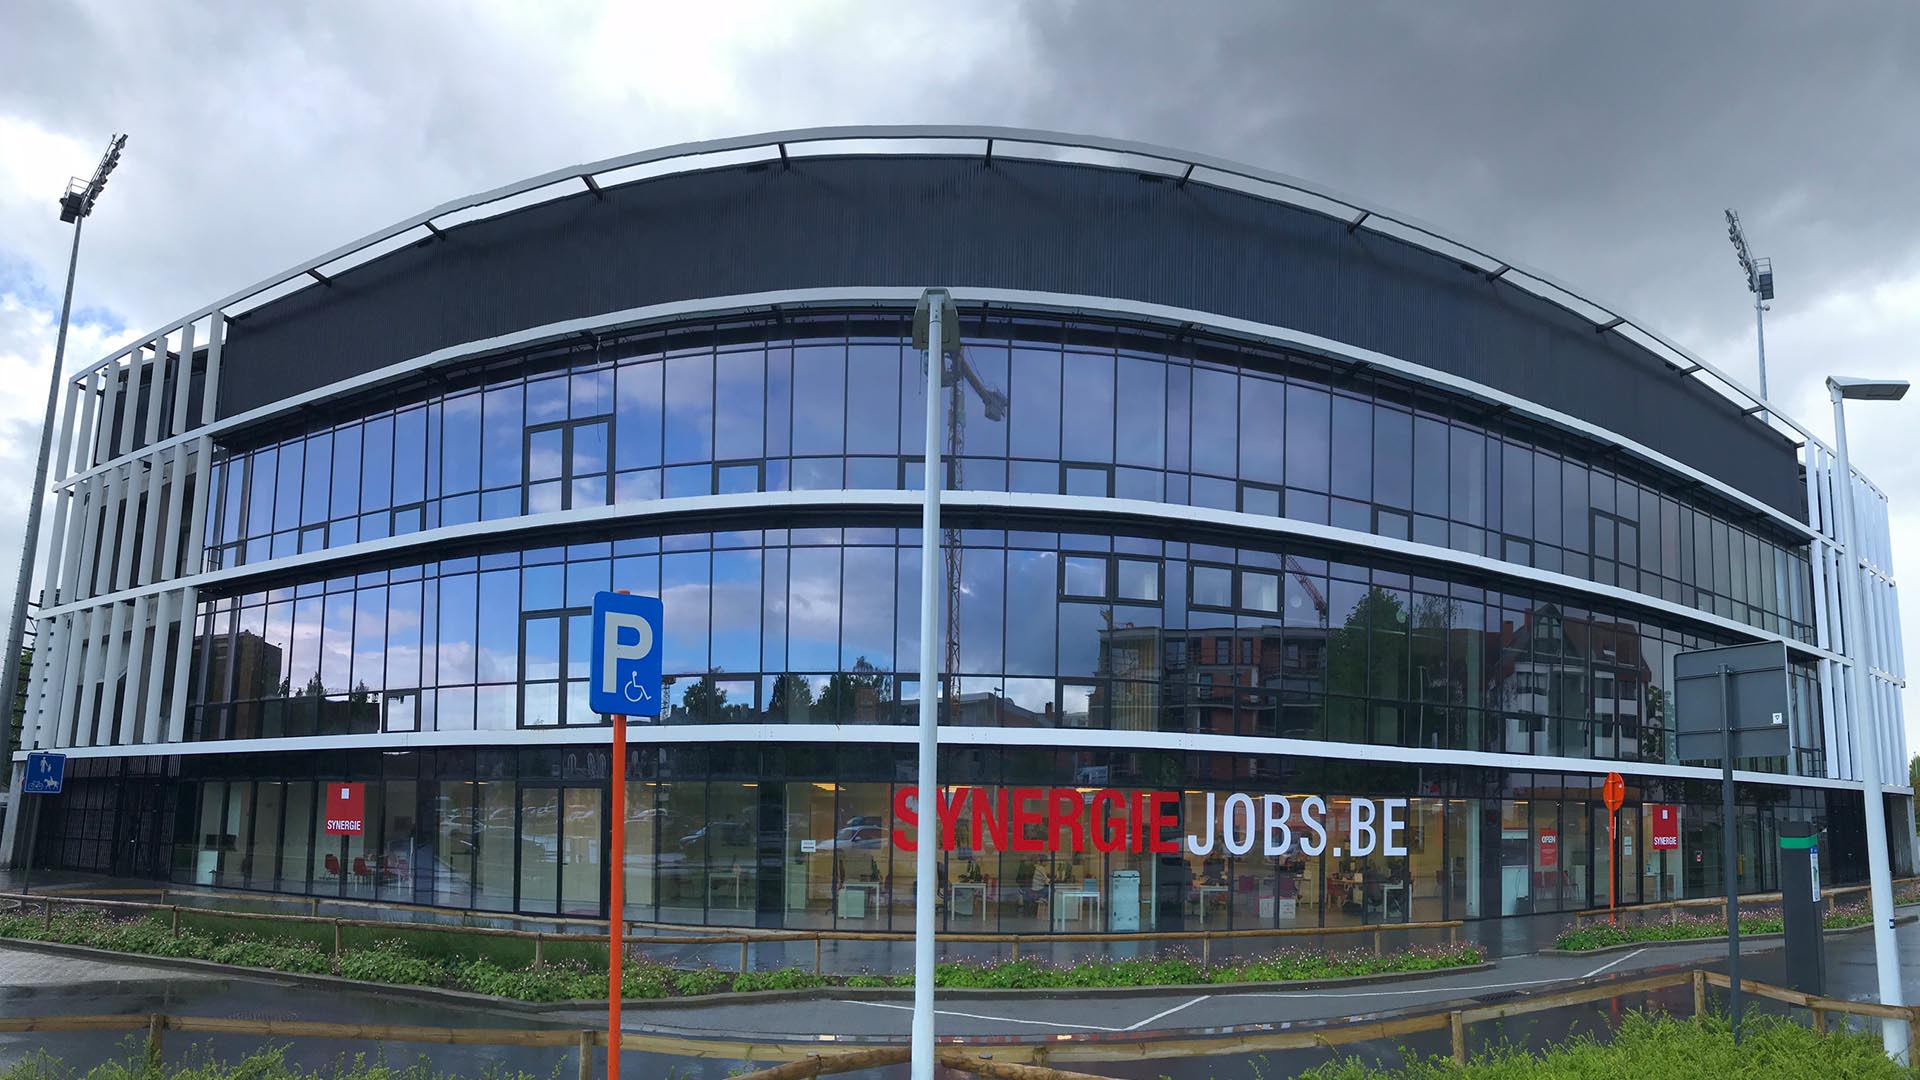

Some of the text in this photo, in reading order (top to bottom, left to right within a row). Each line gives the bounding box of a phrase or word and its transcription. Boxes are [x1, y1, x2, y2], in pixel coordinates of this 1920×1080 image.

[603, 611, 653, 693] P
[327, 820, 361, 831] SYNERGIE
[1654, 836, 1677, 846] SYNERGIE
